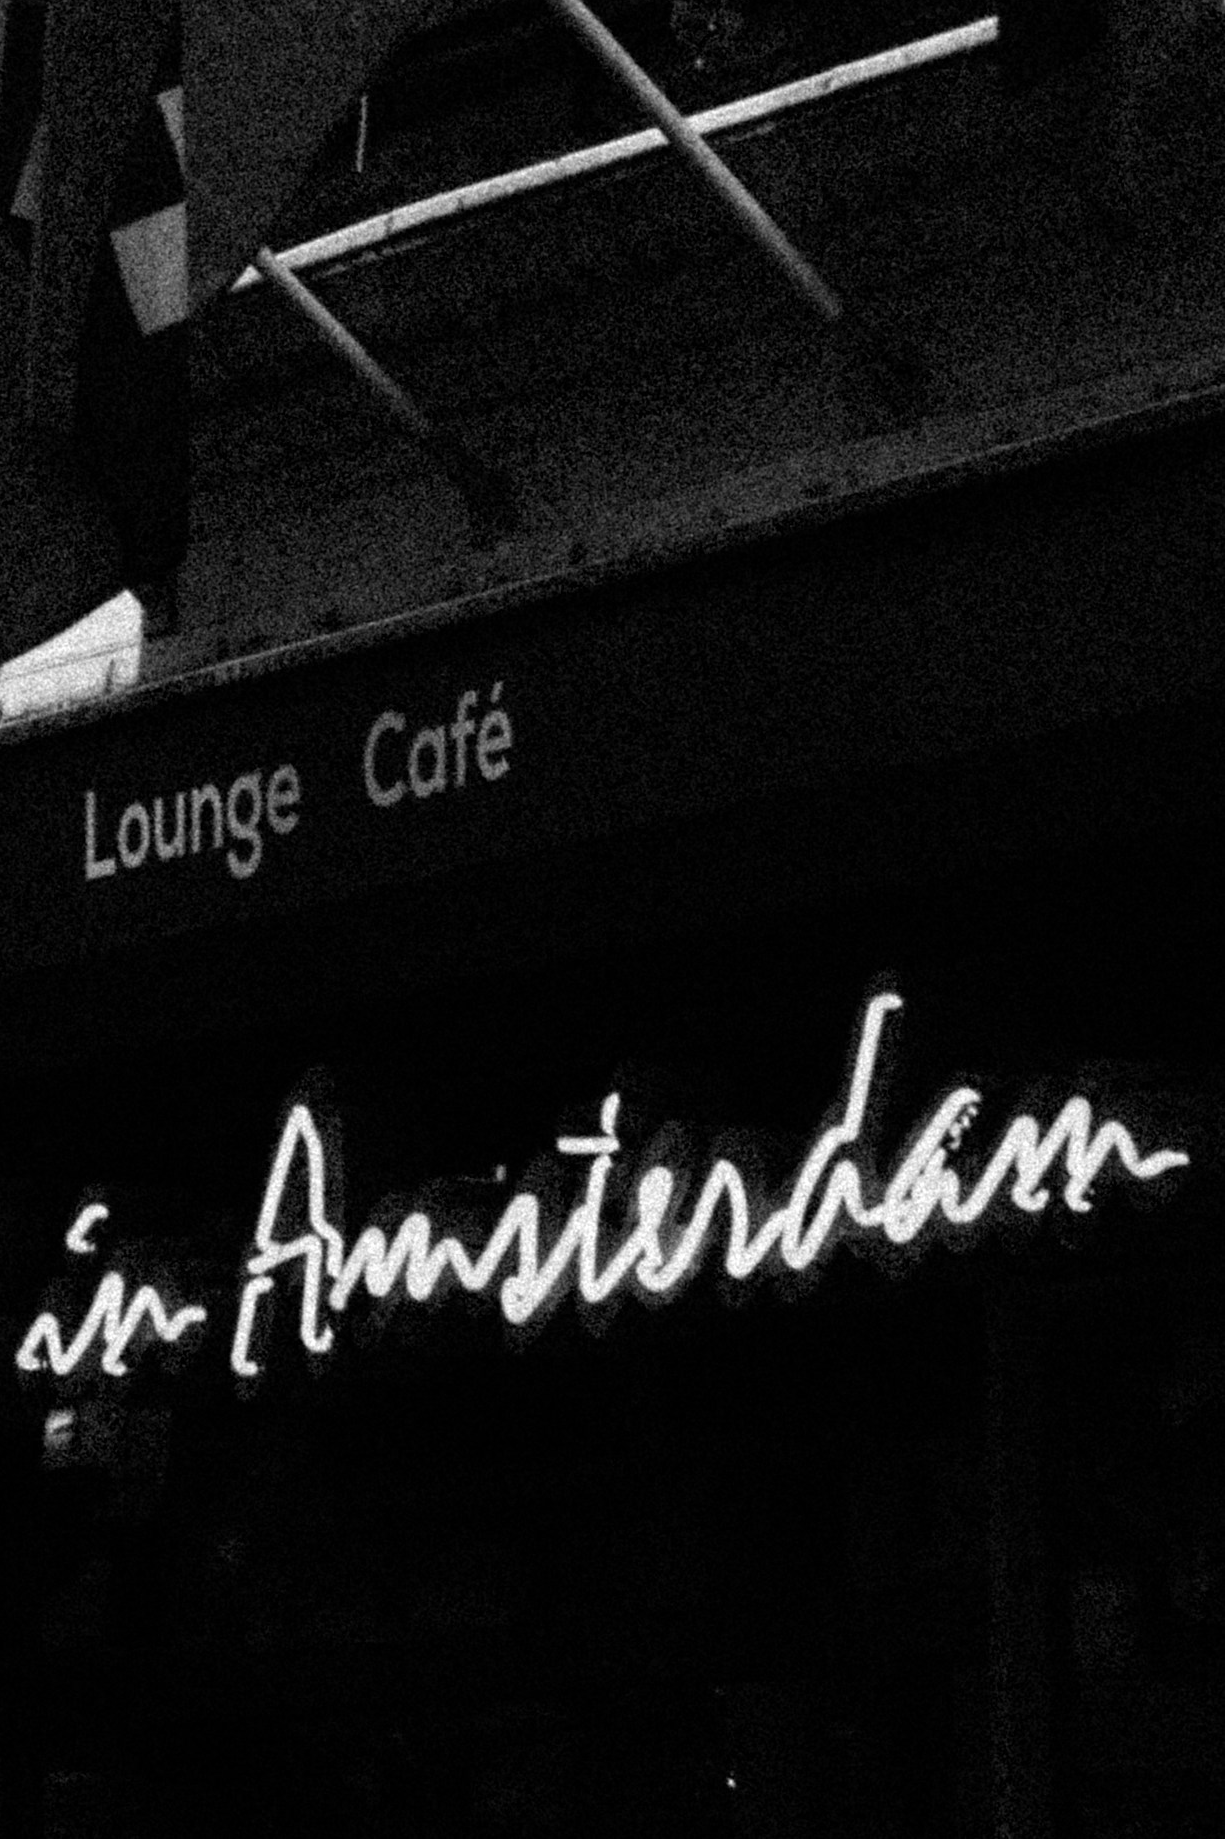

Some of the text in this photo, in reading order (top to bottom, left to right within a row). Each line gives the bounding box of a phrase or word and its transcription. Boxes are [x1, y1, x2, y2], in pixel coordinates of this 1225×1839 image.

[84, 681, 513, 880] Lounge Café
[16, 1203, 206, 1376] in
[230, 992, 1190, 1376] Amsterdam
